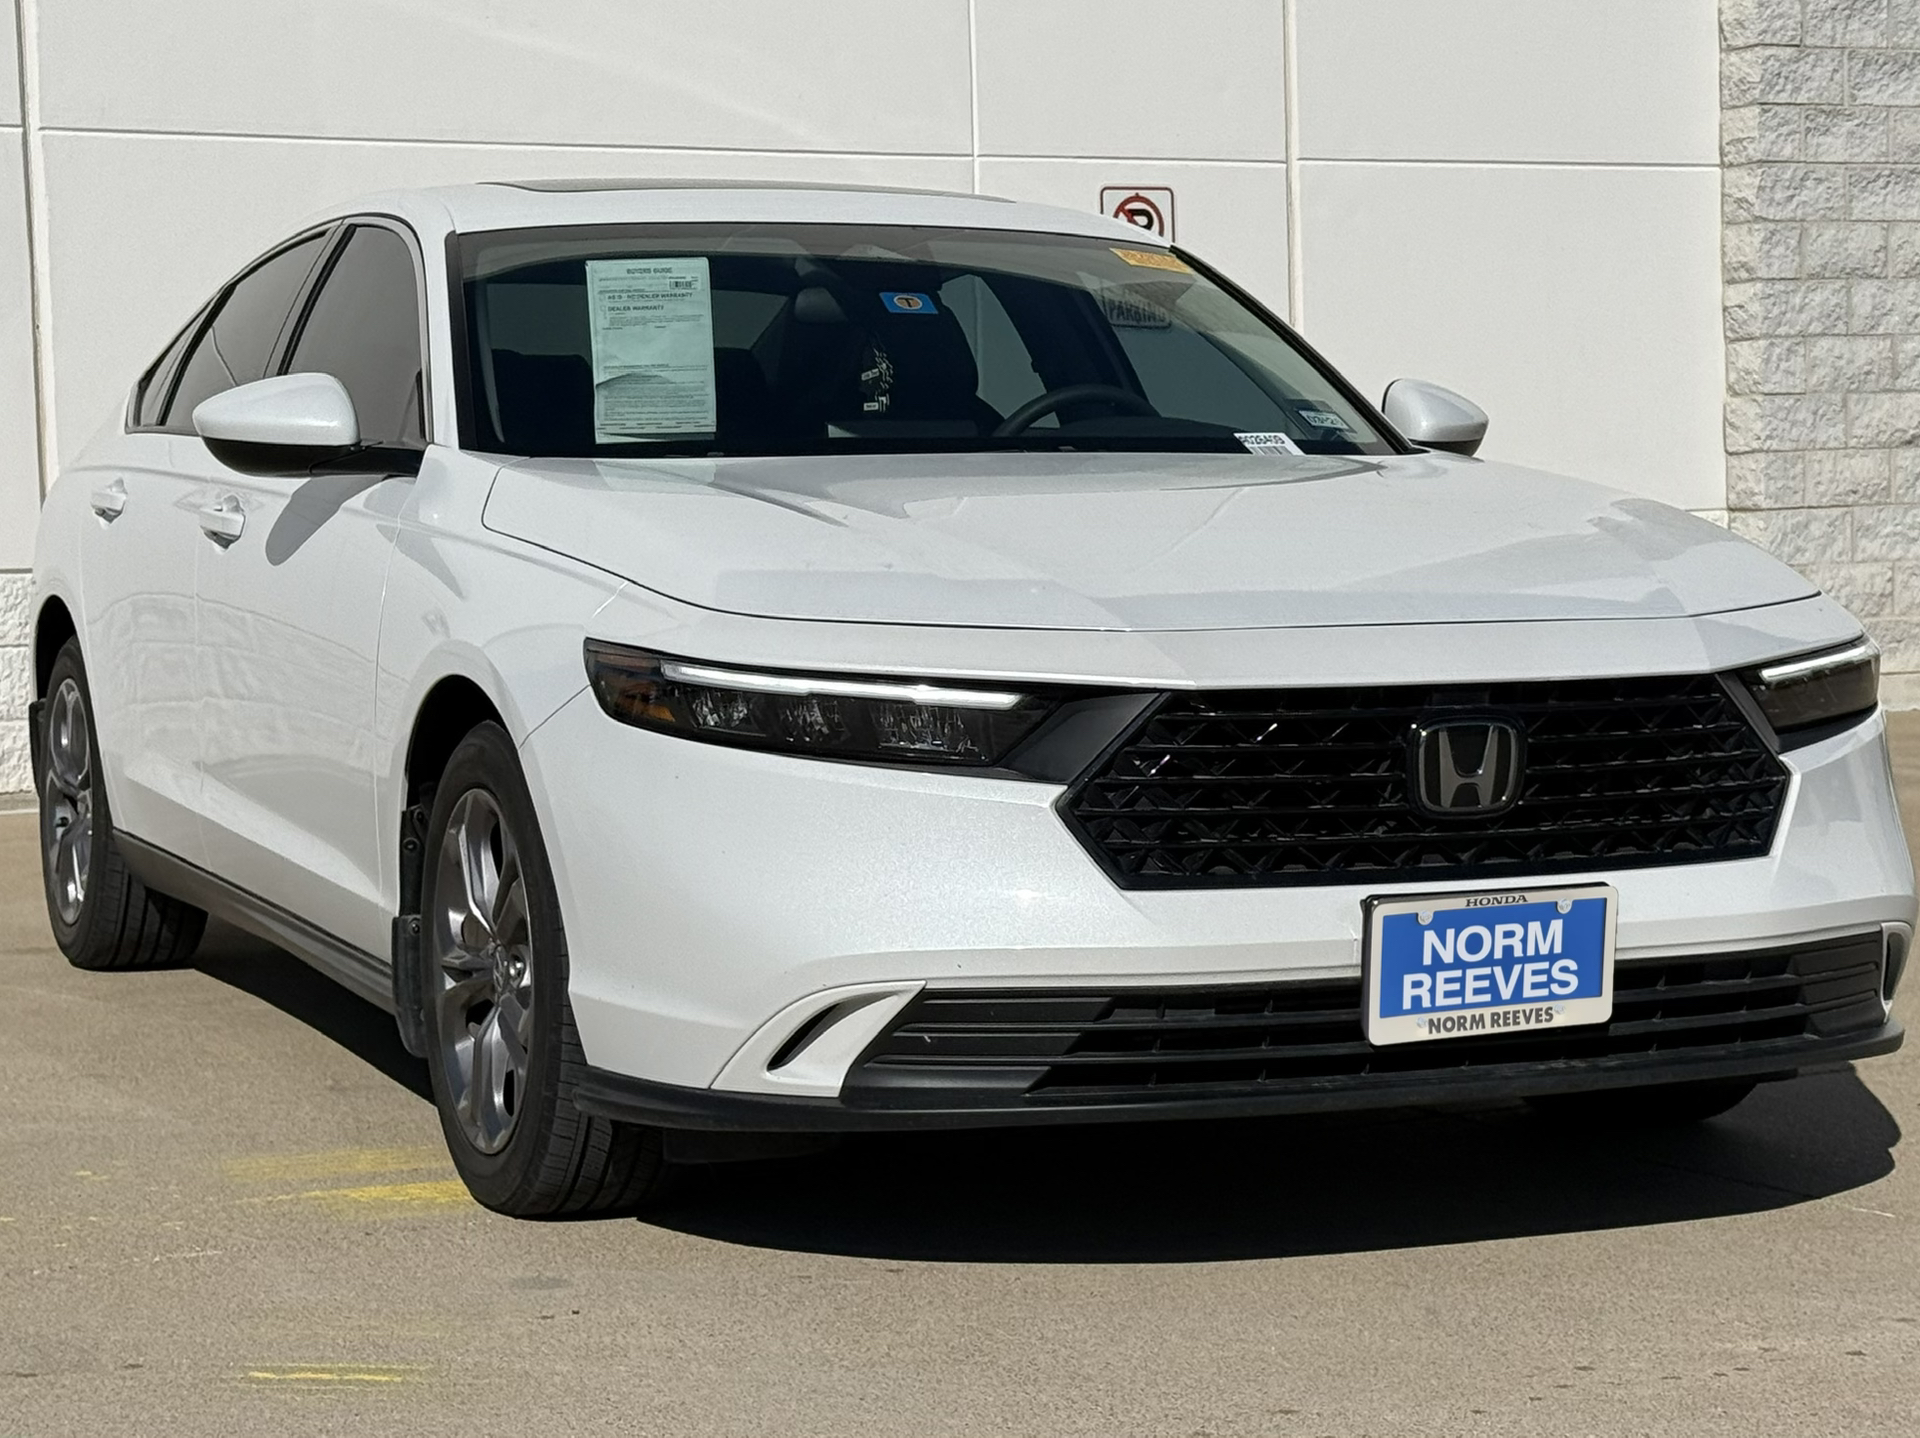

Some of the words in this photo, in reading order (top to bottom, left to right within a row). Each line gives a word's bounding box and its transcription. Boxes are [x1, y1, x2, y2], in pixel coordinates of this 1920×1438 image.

[1464, 894, 1529, 907] HONDA
[1422, 918, 1563, 966] NORM
[1402, 958, 1579, 1010] REEVES
[1428, 1013, 1486, 1035] NORM
[1490, 1006, 1554, 1029] REEVES
